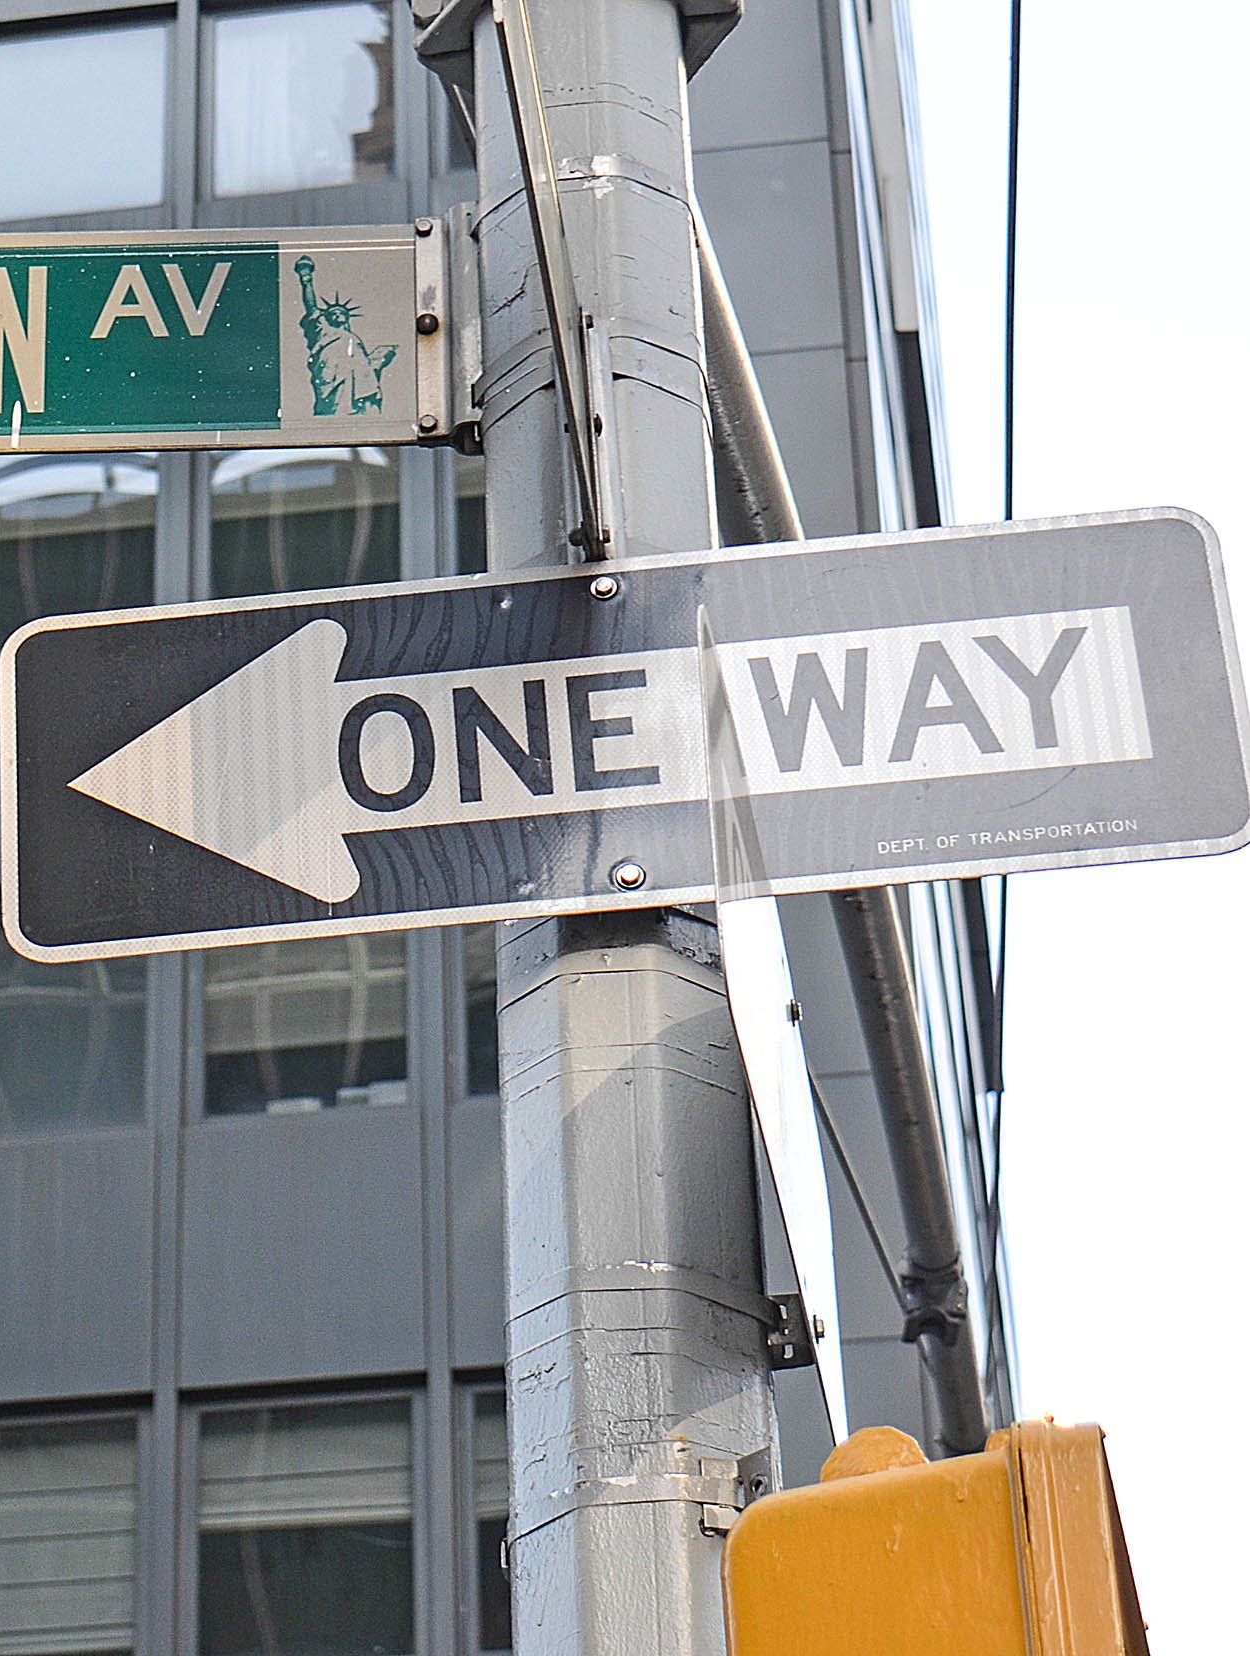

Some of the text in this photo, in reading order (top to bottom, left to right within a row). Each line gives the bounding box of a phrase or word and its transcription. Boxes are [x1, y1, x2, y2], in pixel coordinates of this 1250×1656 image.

[90, 262, 232, 339] AV
[338, 626, 1089, 813] ONE WAY
[877, 819, 1138, 854] DEPT. OF TRANSPORTATION
